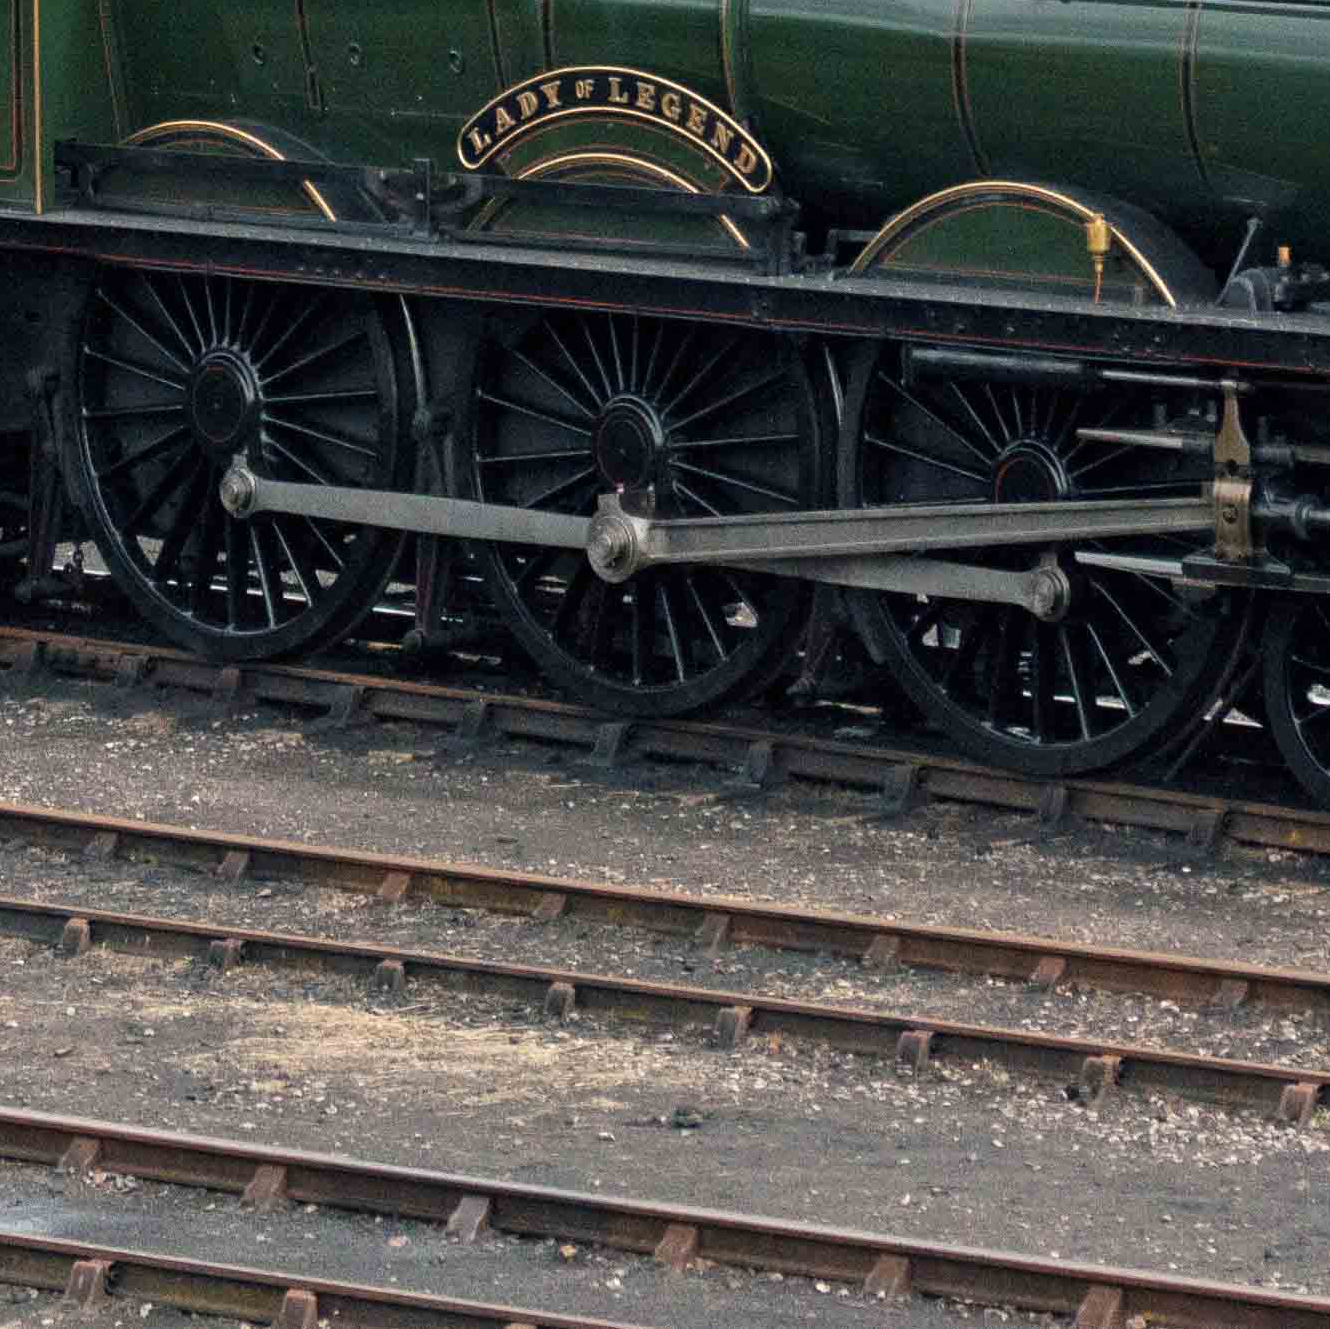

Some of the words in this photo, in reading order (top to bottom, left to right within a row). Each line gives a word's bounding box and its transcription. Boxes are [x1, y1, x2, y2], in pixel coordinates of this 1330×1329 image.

[467, 81, 562, 155] LADY
[575, 79, 595, 100] OF
[608, 77, 758, 174] LEGEND
